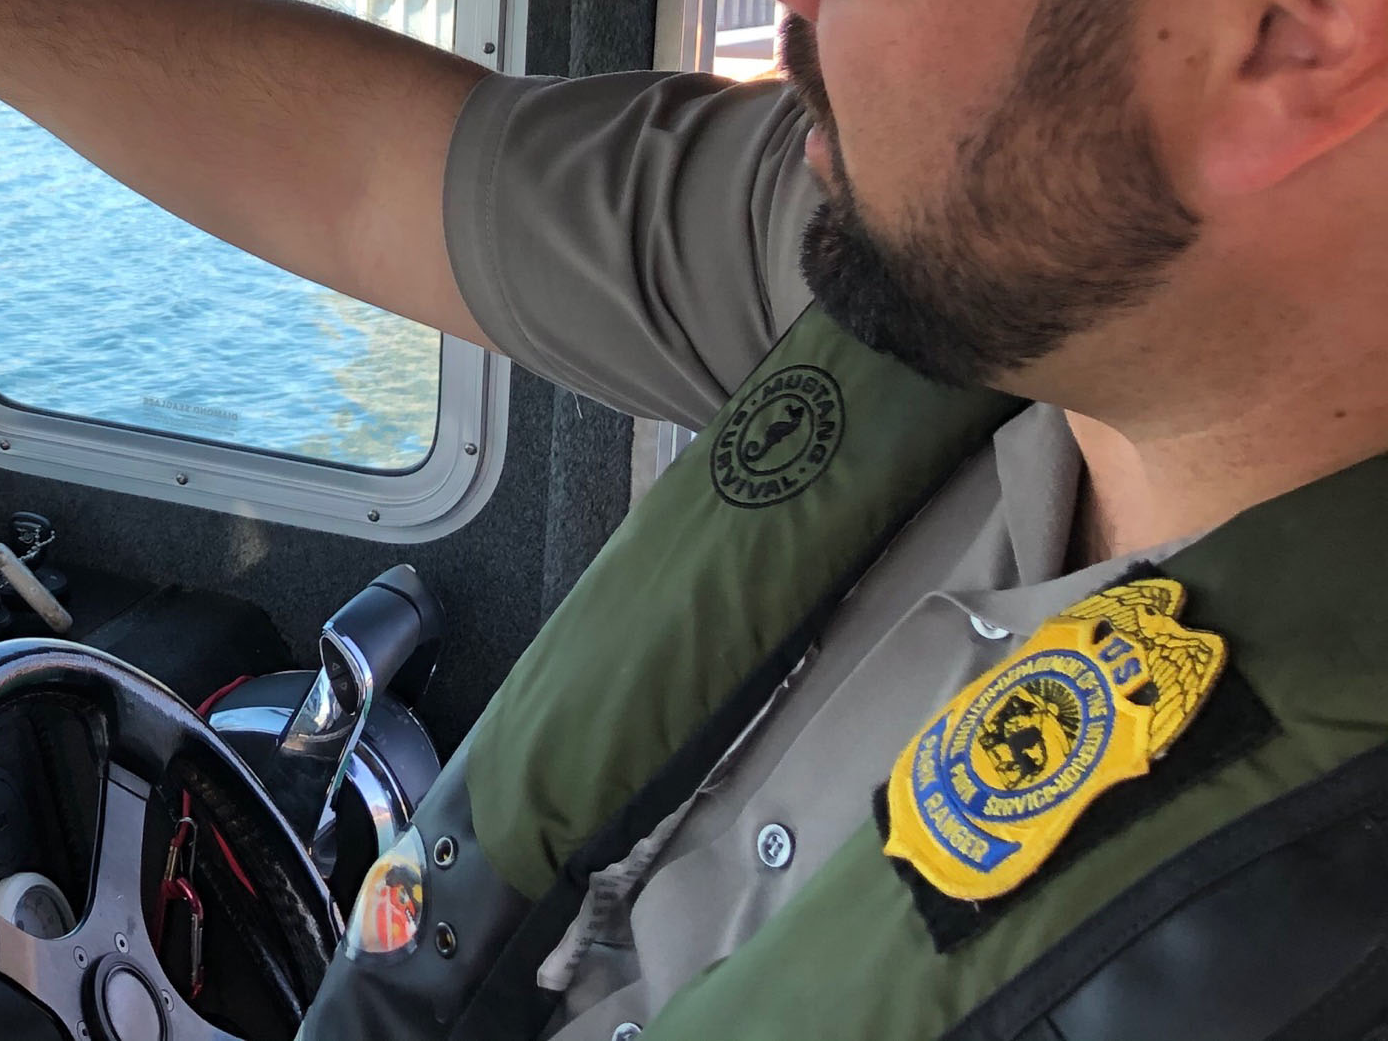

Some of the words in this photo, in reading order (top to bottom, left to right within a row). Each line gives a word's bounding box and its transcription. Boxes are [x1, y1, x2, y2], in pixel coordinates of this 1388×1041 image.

[762, 373, 836, 465] MUSTANG
[716, 410, 799, 499] SURVIVAL
[1076, 670, 1100, 690] OF
[1098, 636, 1143, 686] US
[1086, 688, 1108, 719] THE
[1056, 722, 1106, 792] INTERIOR
[923, 791, 990, 863] RANGER
[982, 787, 1054, 816] SERVICE
